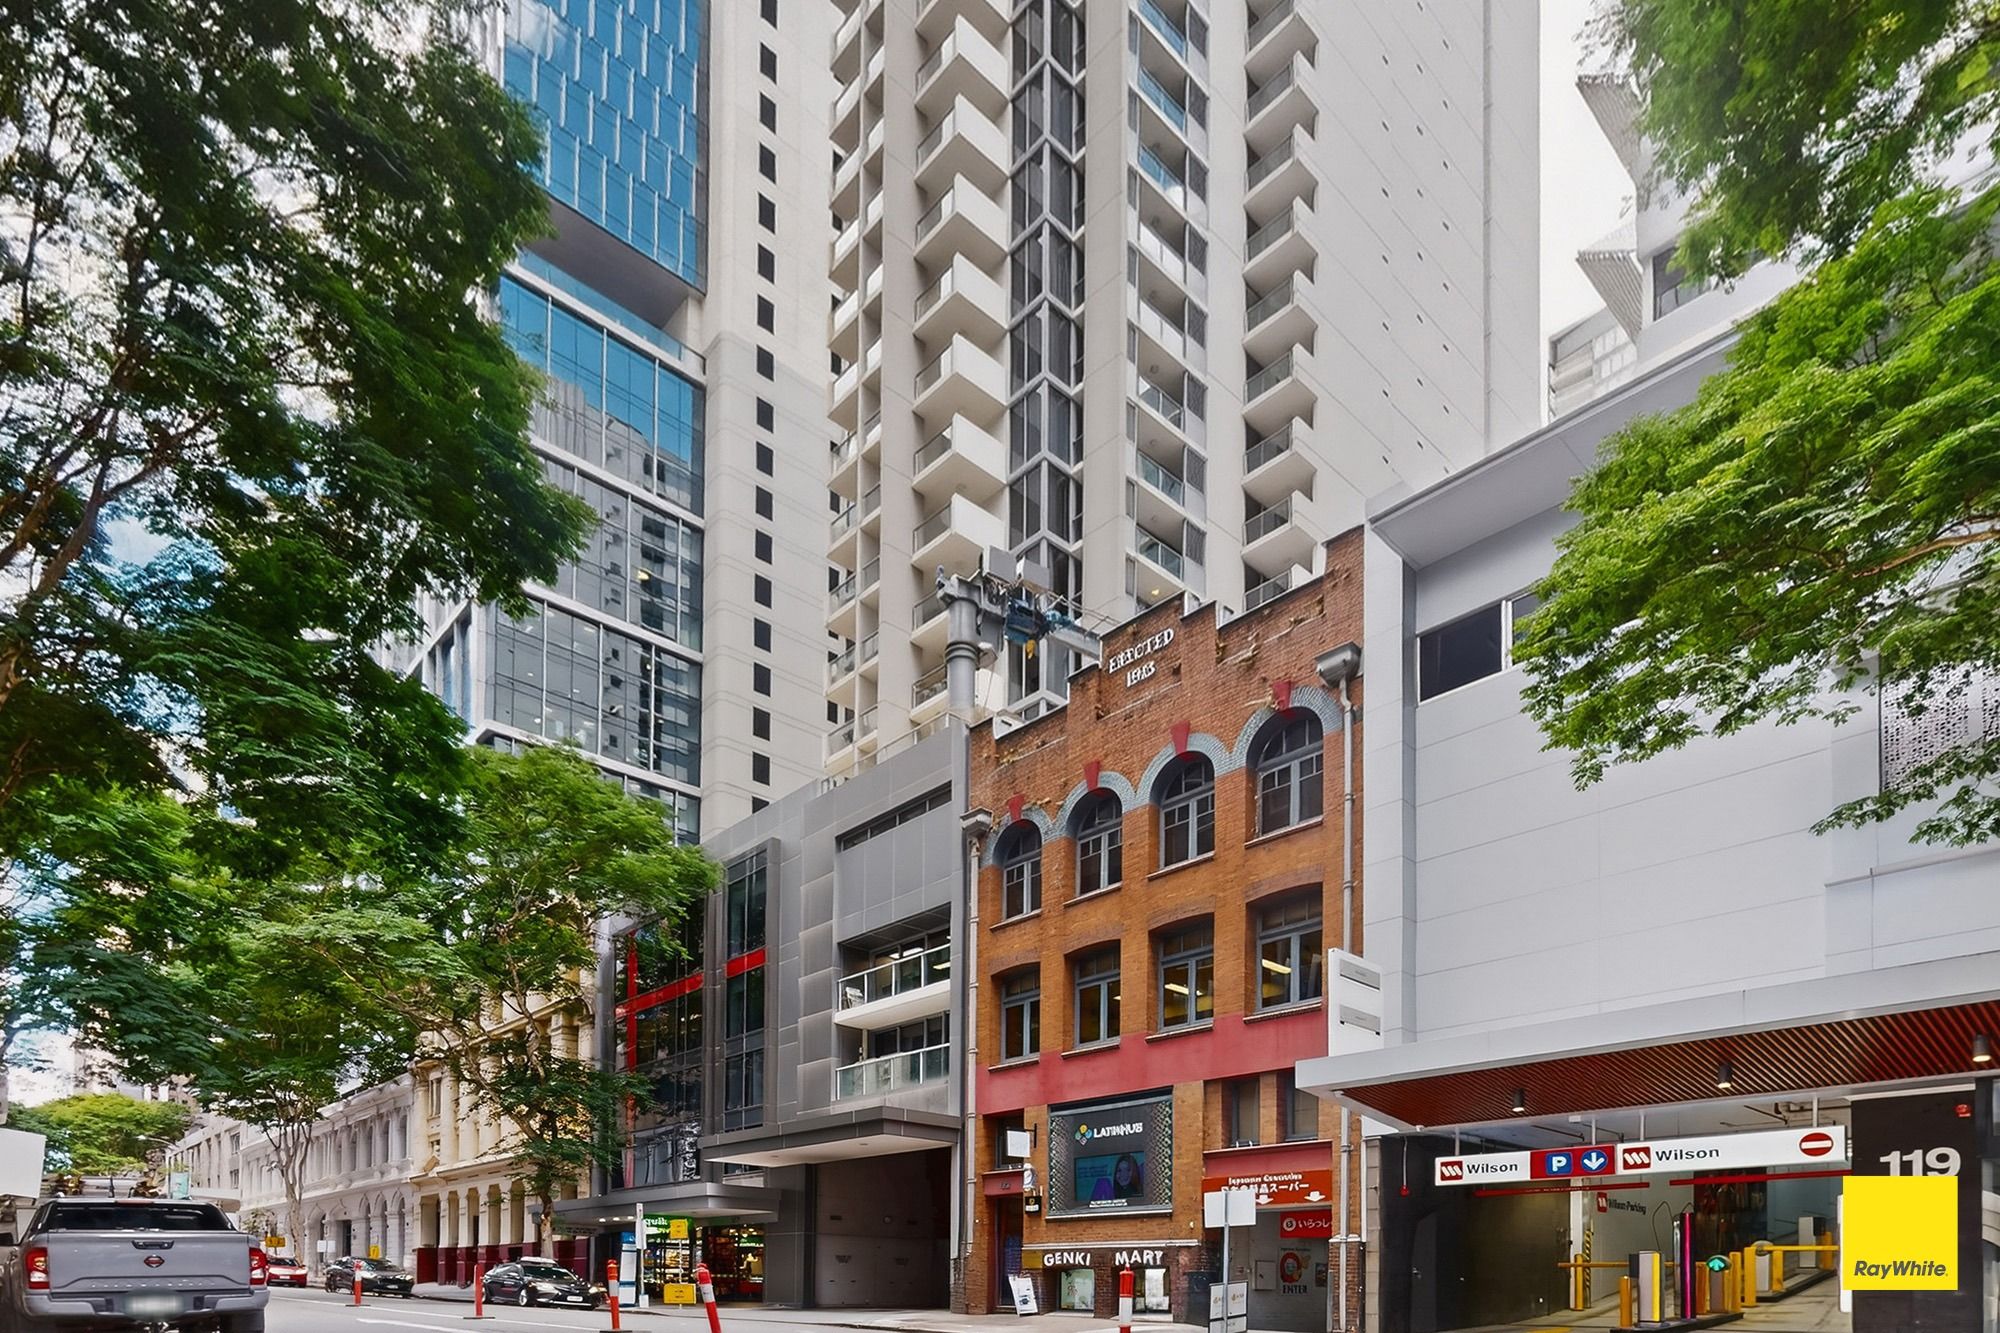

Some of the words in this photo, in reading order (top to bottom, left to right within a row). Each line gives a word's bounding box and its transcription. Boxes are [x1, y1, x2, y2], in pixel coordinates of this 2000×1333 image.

[1655, 1149, 1720, 1161] Wilson
[1466, 1163, 1518, 1175] Wilson
[1551, 1156, 1567, 1171] P
[1626, 1201, 1646, 1215] Parking
[1043, 1252, 1091, 1267] GENKI
